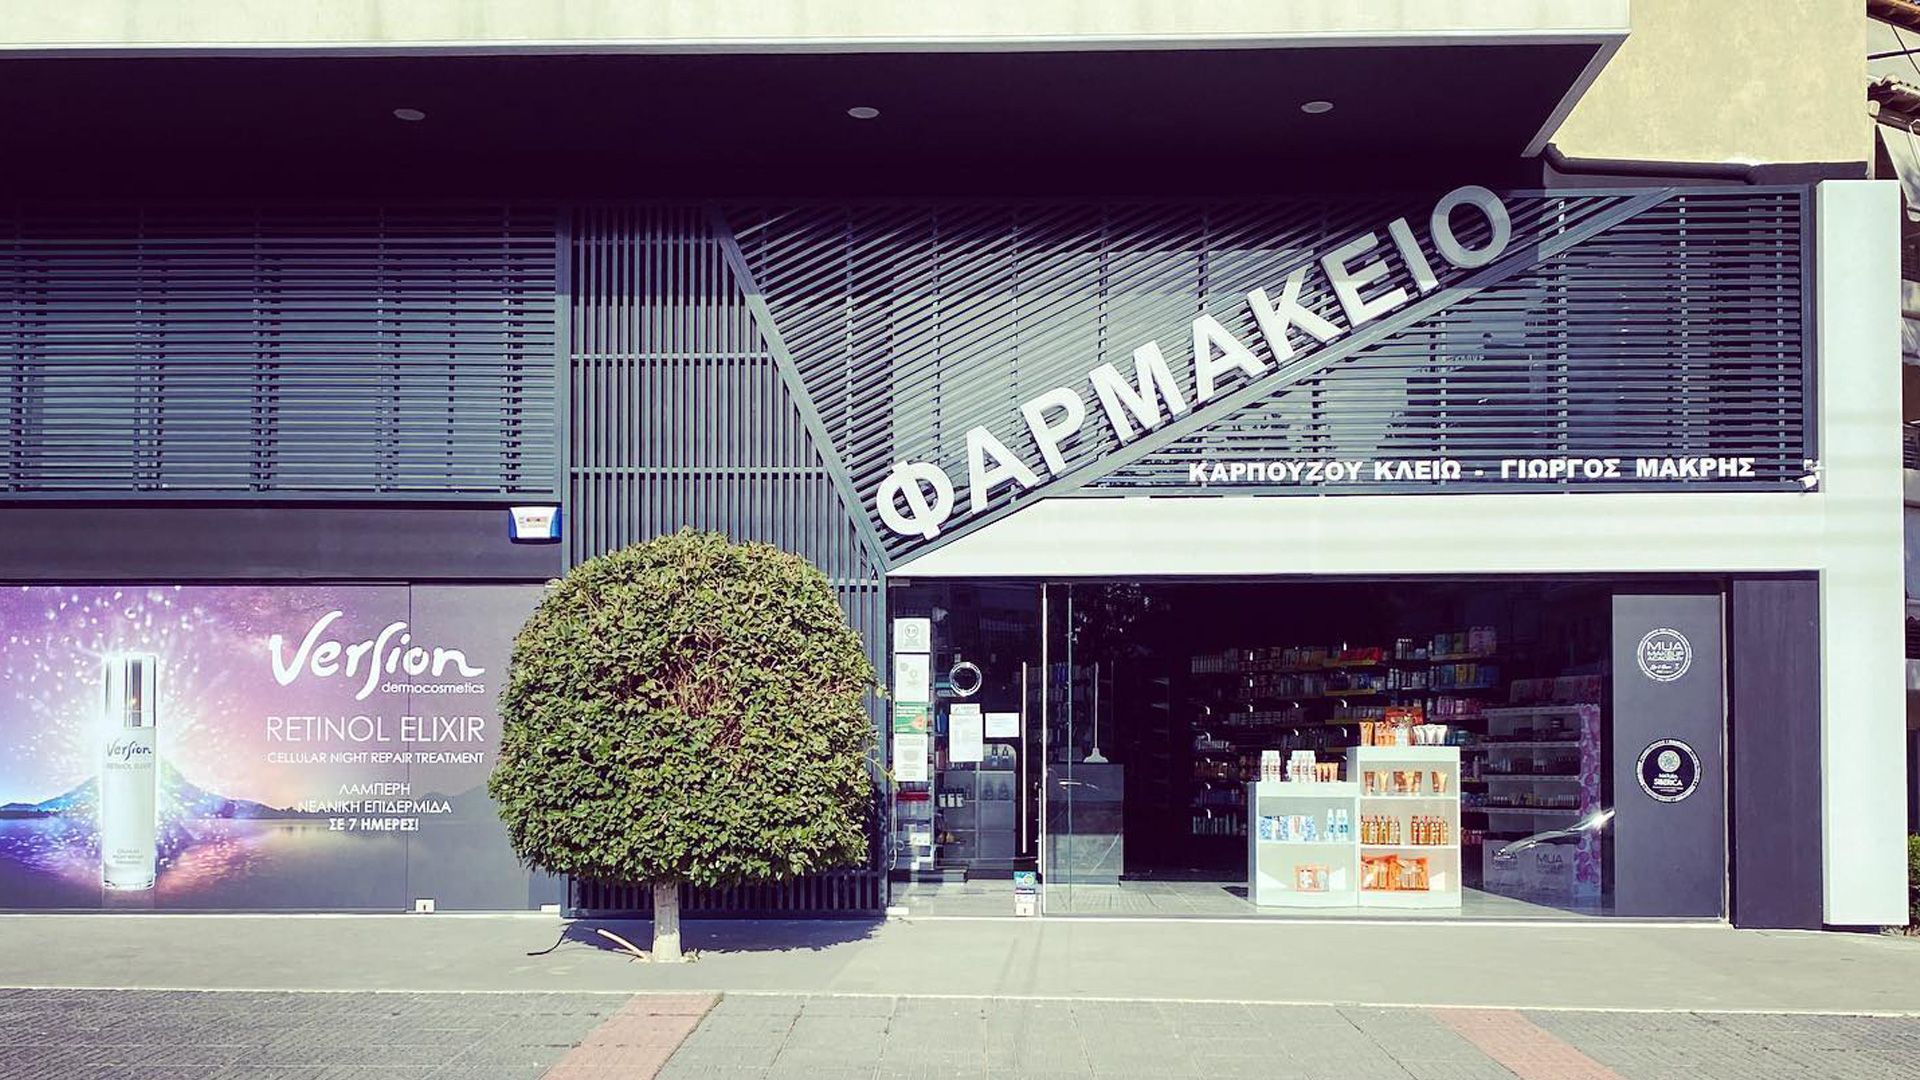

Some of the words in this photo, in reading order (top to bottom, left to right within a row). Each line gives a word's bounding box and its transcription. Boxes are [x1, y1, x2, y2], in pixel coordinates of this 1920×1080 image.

[876, 185, 1512, 540] ΦΑΡΜΑΚΕΙΟ
[1189, 460, 1363, 483] ΚΑΡΠΟΥΖΟΥ
[1374, 459, 1462, 481] ΚΛΕΙΩ
[1500, 458, 1621, 480] ΓΙΩΡΓΟΣ
[1635, 457, 1756, 480] ΜΑΚΡΗΣ
[1647, 641, 1683, 651] MUA
[269, 610, 485, 700] Version
[381, 681, 485, 694] dermocosmetics
[267, 716, 390, 742] RETINOL
[401, 716, 485, 742] ELIXIR
[267, 753, 327, 763] CELLULAR
[330, 752, 368, 763] NIGHT
[371, 752, 412, 763] REPAIR
[415, 752, 484, 763] TREATMENT
[338, 783, 411, 796] ΛΑΜΠΕΡΗ
[297, 801, 360, 813] ΝΕΑΝΙΚΗ
[364, 801, 452, 813] ΕΠΙΔΕΡΜΙΔΑ
[328, 819, 346, 831] ΣΕ
[349, 819, 356, 831] 7
[360, 819, 419, 831] ΗΜΕΡΕΣ!
